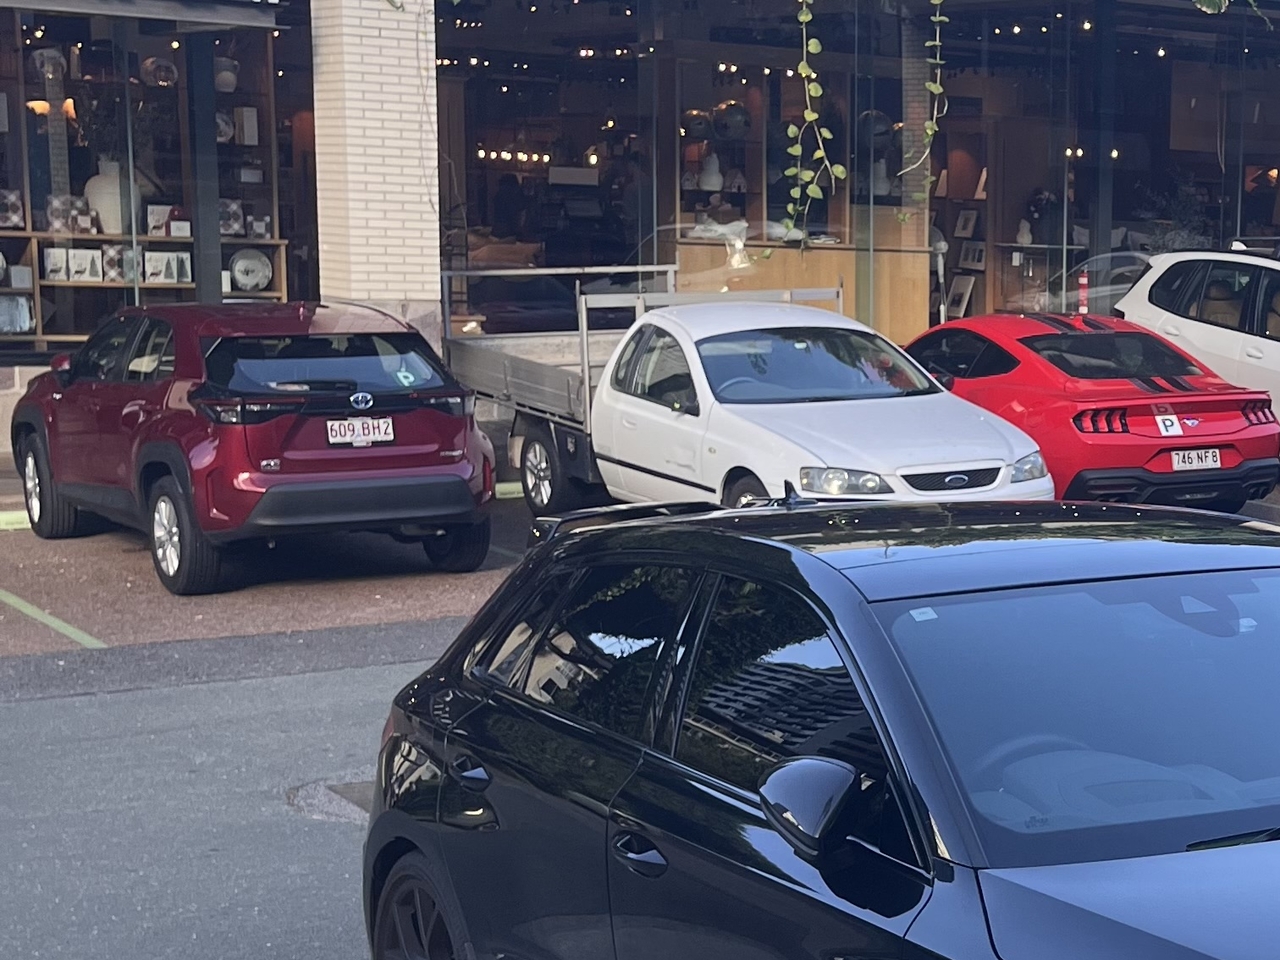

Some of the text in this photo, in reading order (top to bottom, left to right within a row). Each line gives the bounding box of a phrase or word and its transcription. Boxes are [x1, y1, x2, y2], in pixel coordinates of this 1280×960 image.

[397, 371, 415, 387] P
[329, 419, 391, 439] 609 BH2
[1160, 418, 1174, 433] P
[1174, 451, 1193, 465] 746
